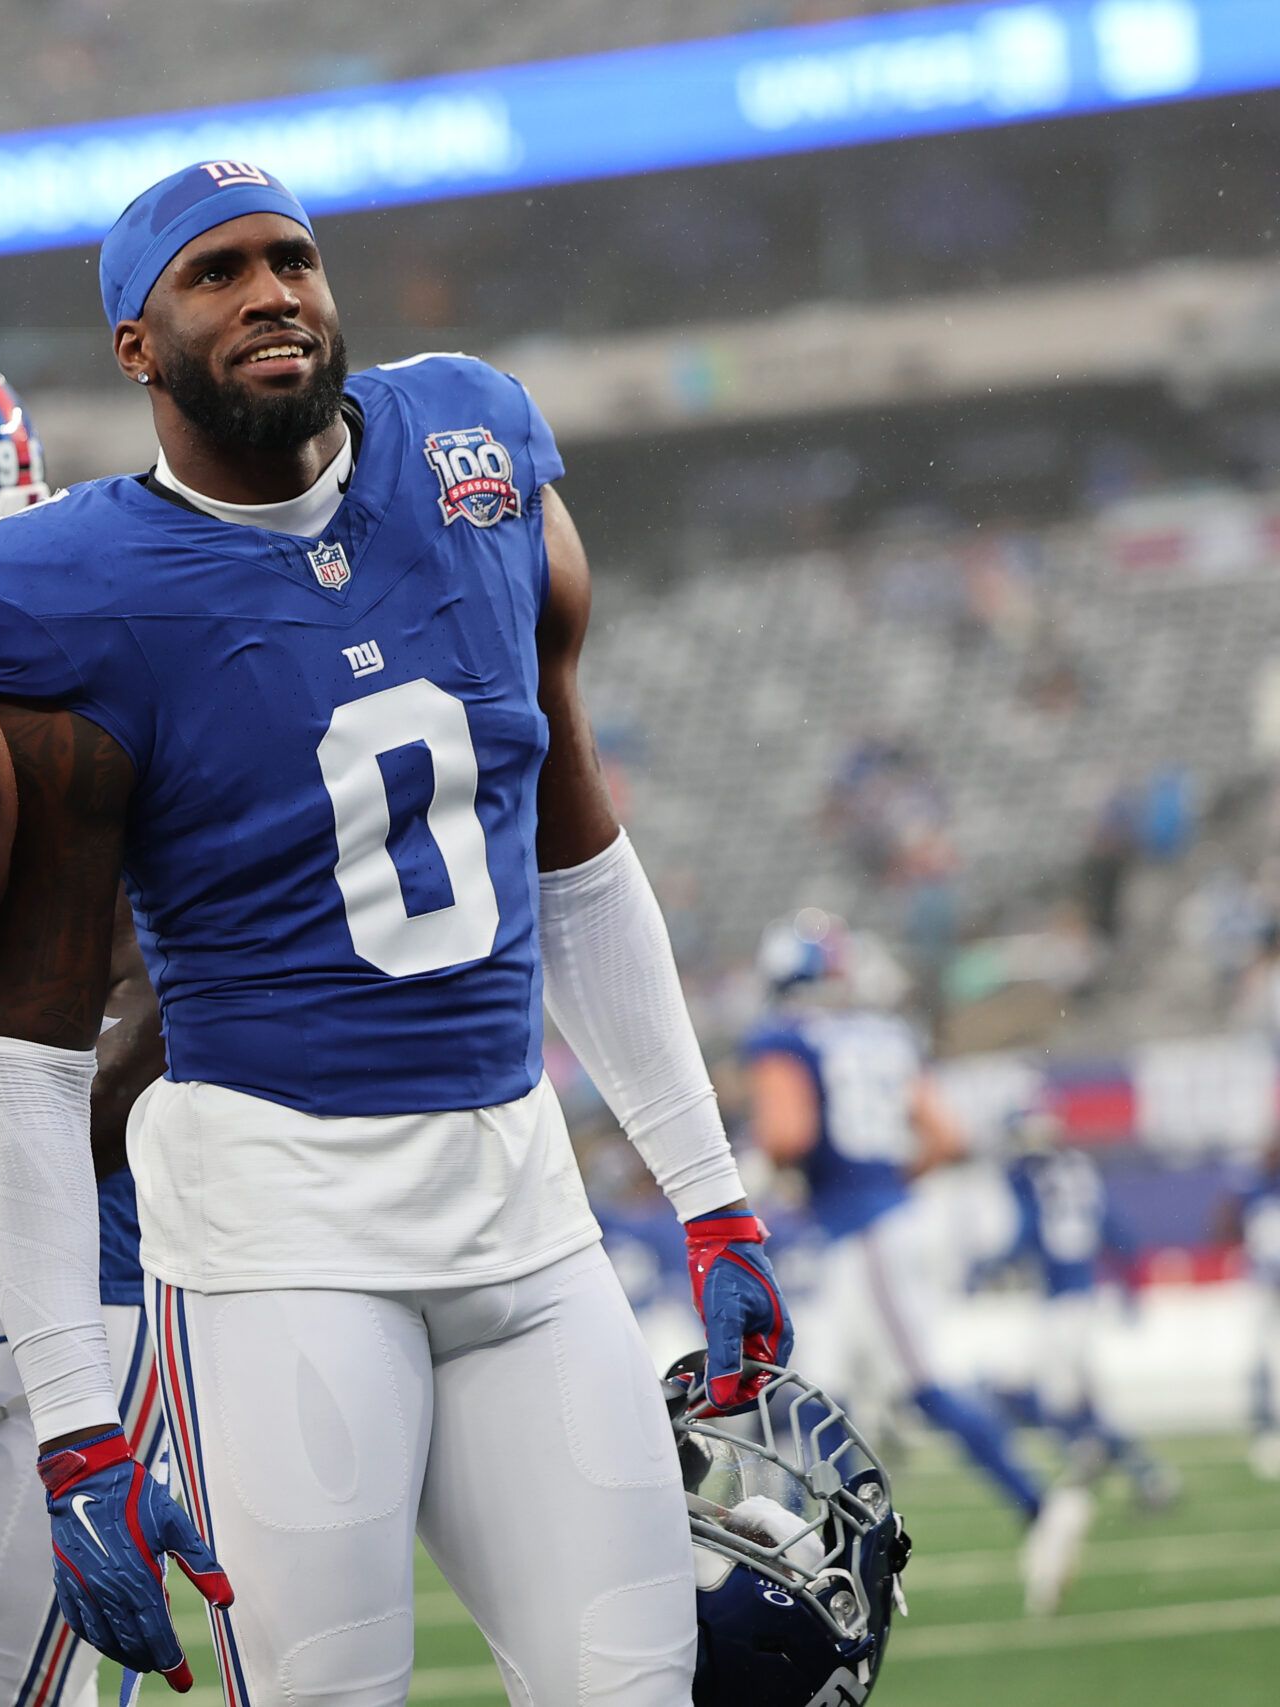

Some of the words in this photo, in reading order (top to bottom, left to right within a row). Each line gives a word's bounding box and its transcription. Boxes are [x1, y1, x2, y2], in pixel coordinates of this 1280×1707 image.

[430, 443, 510, 488] 100
[451, 481, 507, 499] SEASONS
[320, 562, 346, 582] NFL
[316, 677, 500, 977] 0
